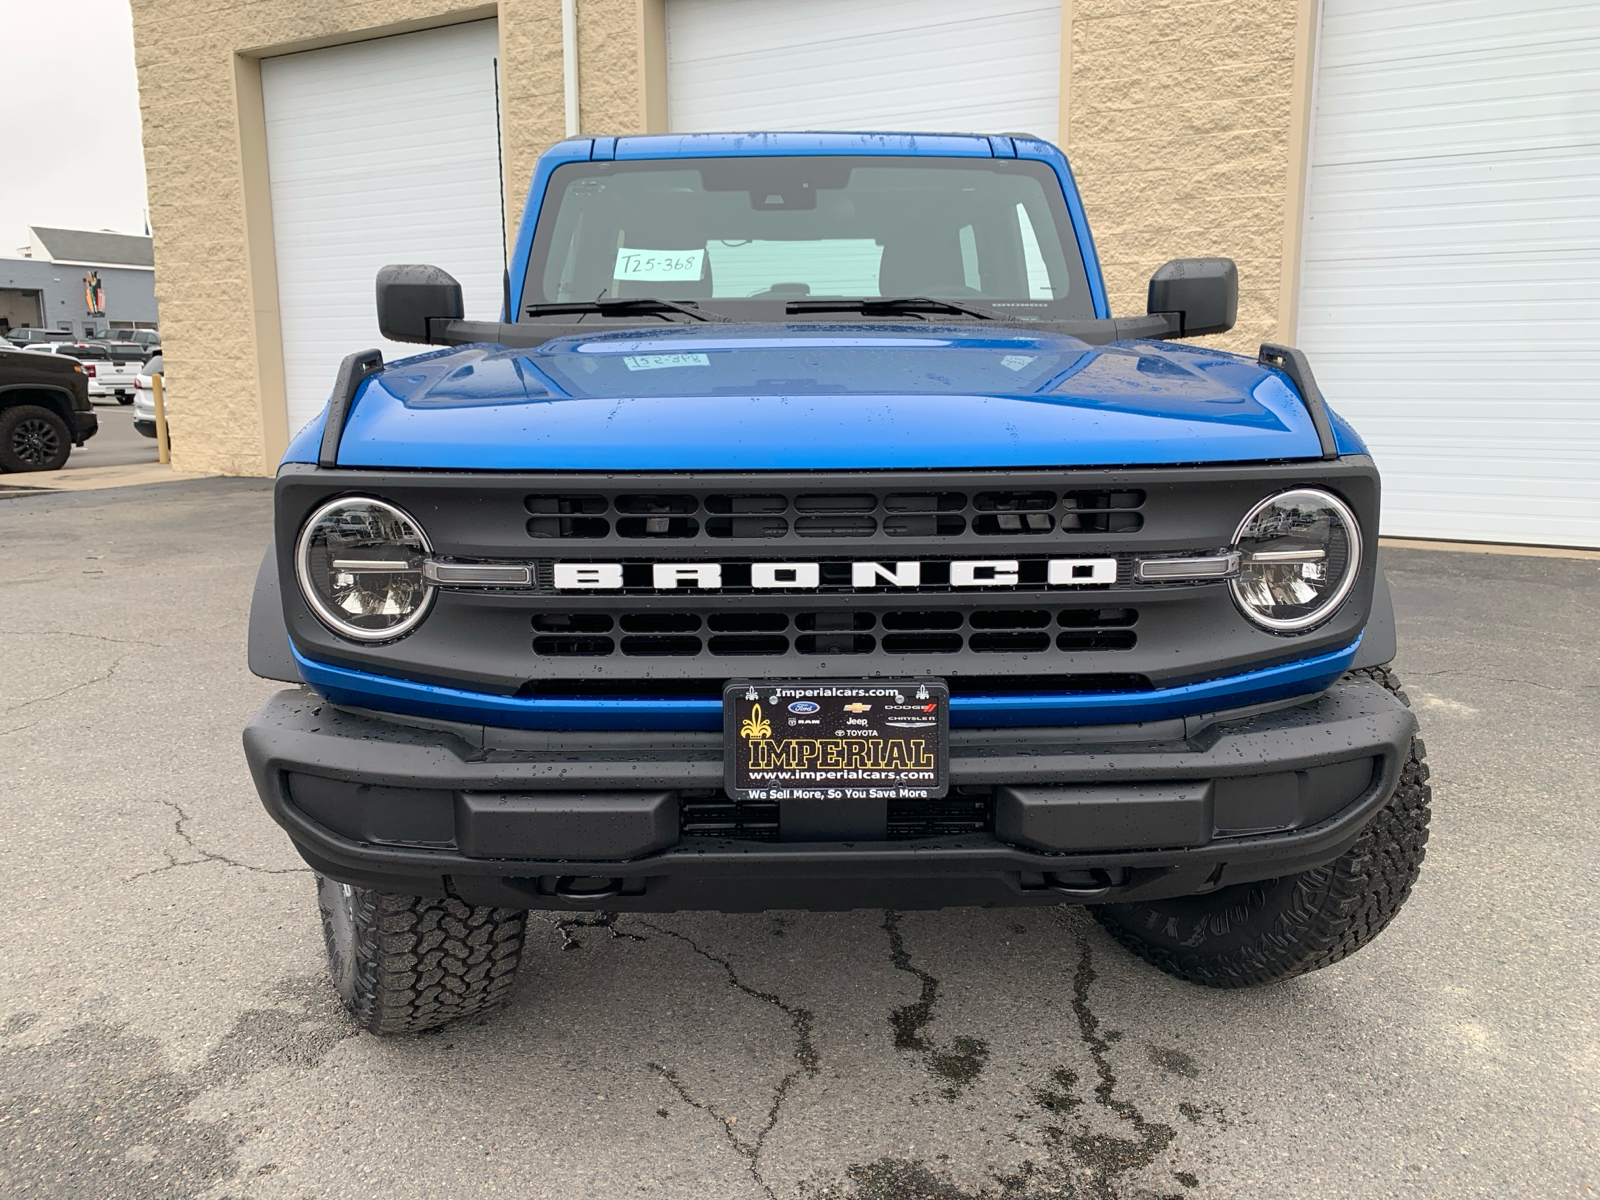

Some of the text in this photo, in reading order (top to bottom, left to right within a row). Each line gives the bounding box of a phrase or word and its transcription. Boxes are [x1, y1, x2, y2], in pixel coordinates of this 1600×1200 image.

[621, 254, 695, 273] T25-368
[553, 558, 1117, 589] BRONCO
[775, 687, 899, 699] Imperialcars.com
[846, 717, 868, 727] Jeep
[749, 739, 934, 769] IMPERIAL
[749, 769, 934, 781] www.imperialcars.com
[749, 789, 927, 800] We Sell More, So You Save More
